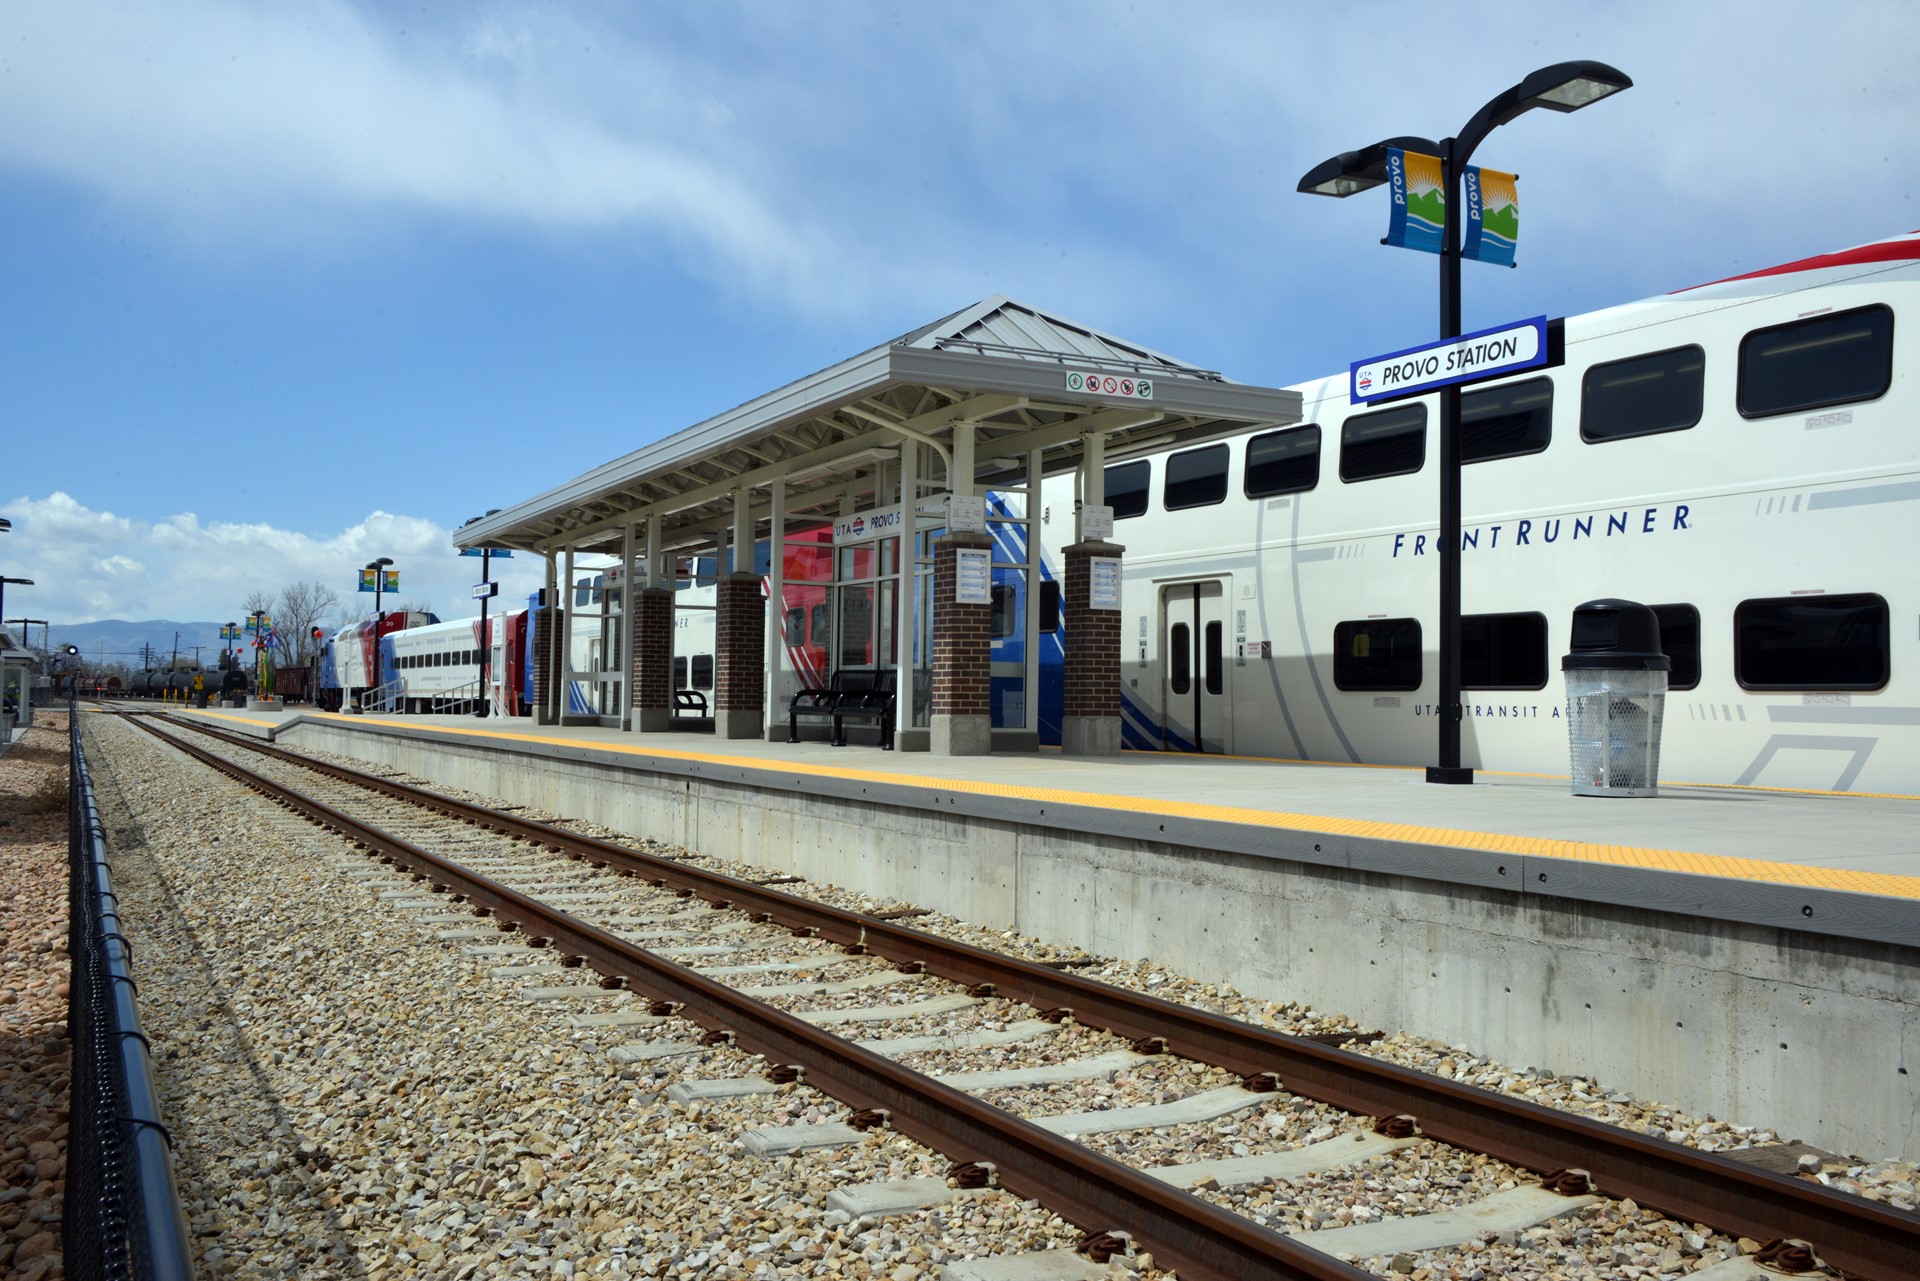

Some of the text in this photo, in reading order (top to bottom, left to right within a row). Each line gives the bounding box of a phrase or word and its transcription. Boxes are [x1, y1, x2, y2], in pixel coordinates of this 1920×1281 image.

[1391, 156, 1405, 205] provo
[1467, 172, 1480, 220] provo
[1359, 371, 1372, 379] UTA
[1382, 337, 1517, 386] PROVO STATION
[836, 524, 851, 537] UTA
[870, 513, 894, 530] PROVO
[1466, 705, 1538, 718] TRANSIT
